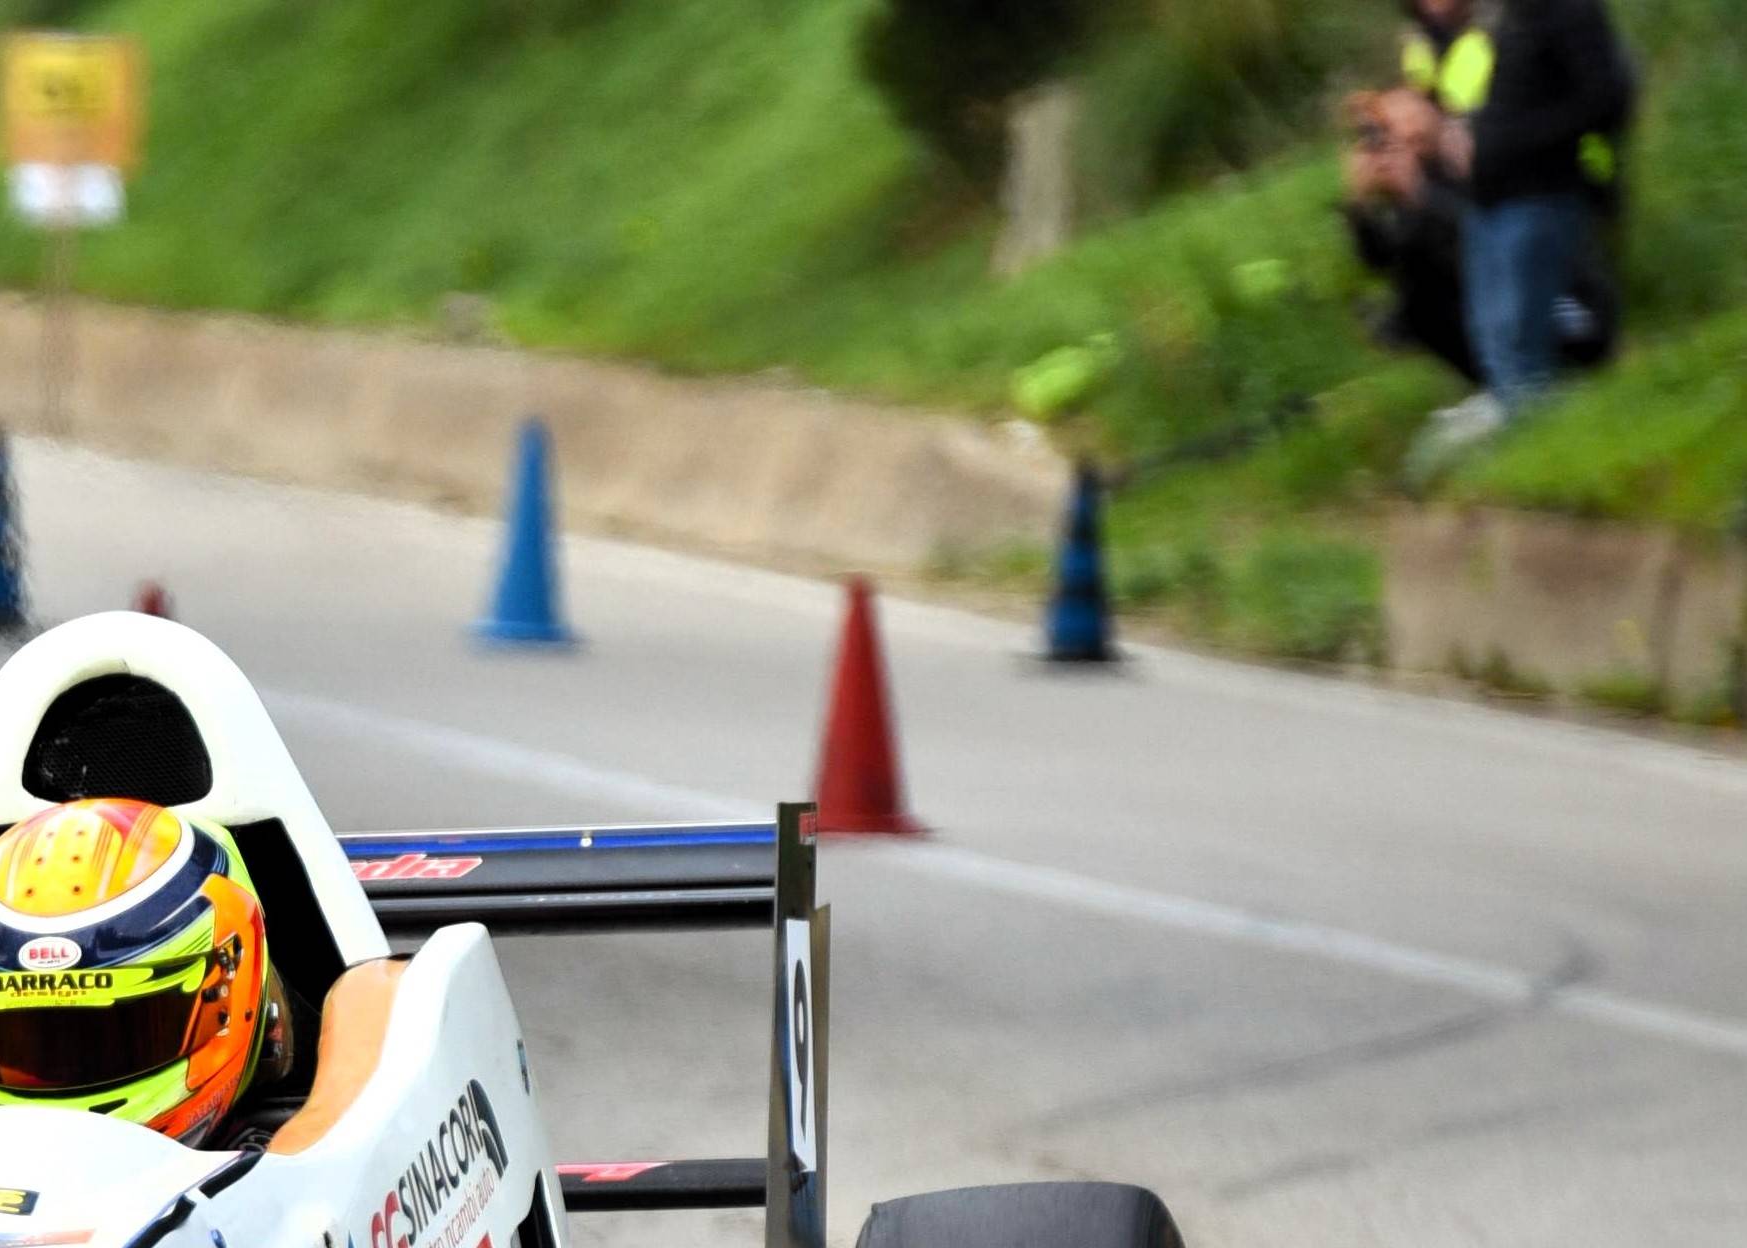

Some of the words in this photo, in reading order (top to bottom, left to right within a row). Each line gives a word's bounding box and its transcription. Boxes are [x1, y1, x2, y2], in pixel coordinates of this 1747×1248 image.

[29, 947, 69, 960] BELL
[794, 958, 809, 1142] 9
[398, 1081, 484, 1247] SINACORI
[476, 1166, 496, 1220] auto
